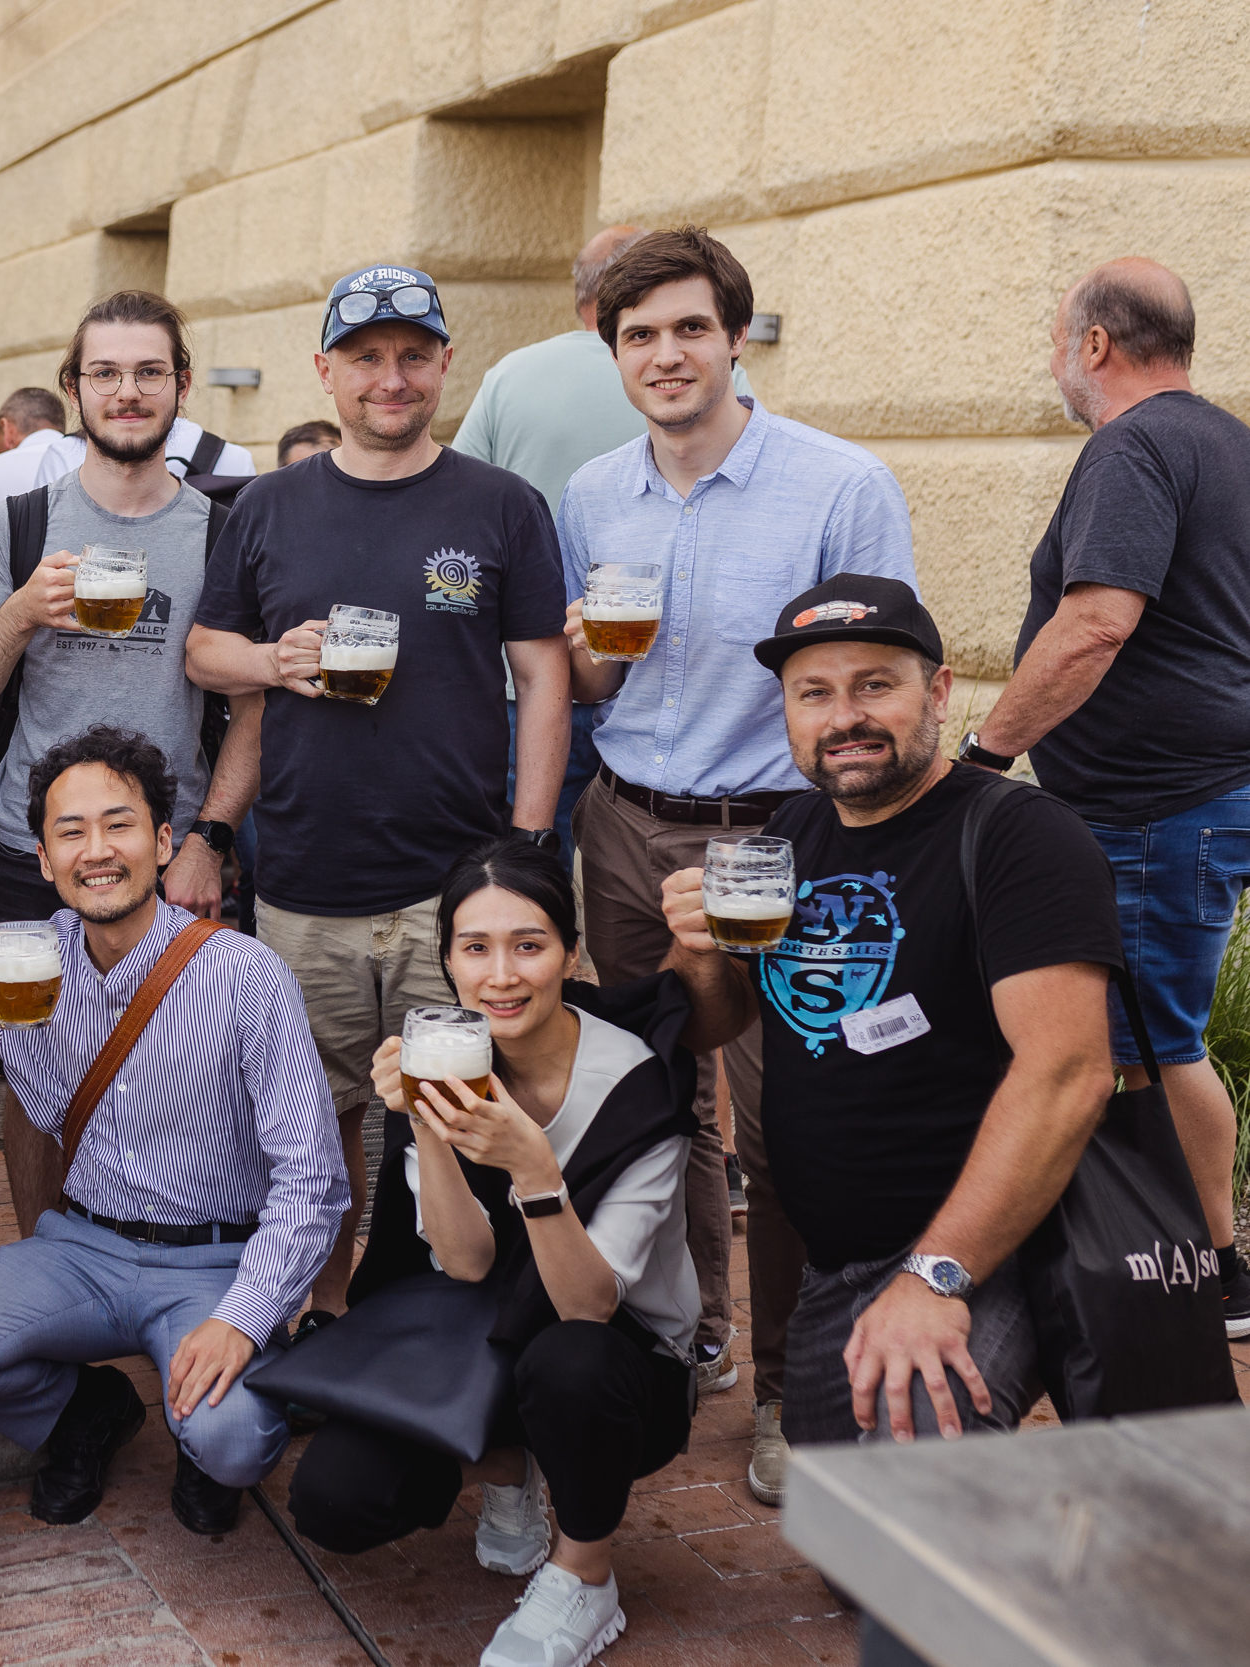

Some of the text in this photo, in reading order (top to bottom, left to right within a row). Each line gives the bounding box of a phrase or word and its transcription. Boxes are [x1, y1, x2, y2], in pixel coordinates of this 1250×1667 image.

[56, 640, 74, 649] EST.
[77, 641, 97, 650] 1997
[778, 942, 891, 956] ORTH SAILS
[790, 969, 847, 1015] S
